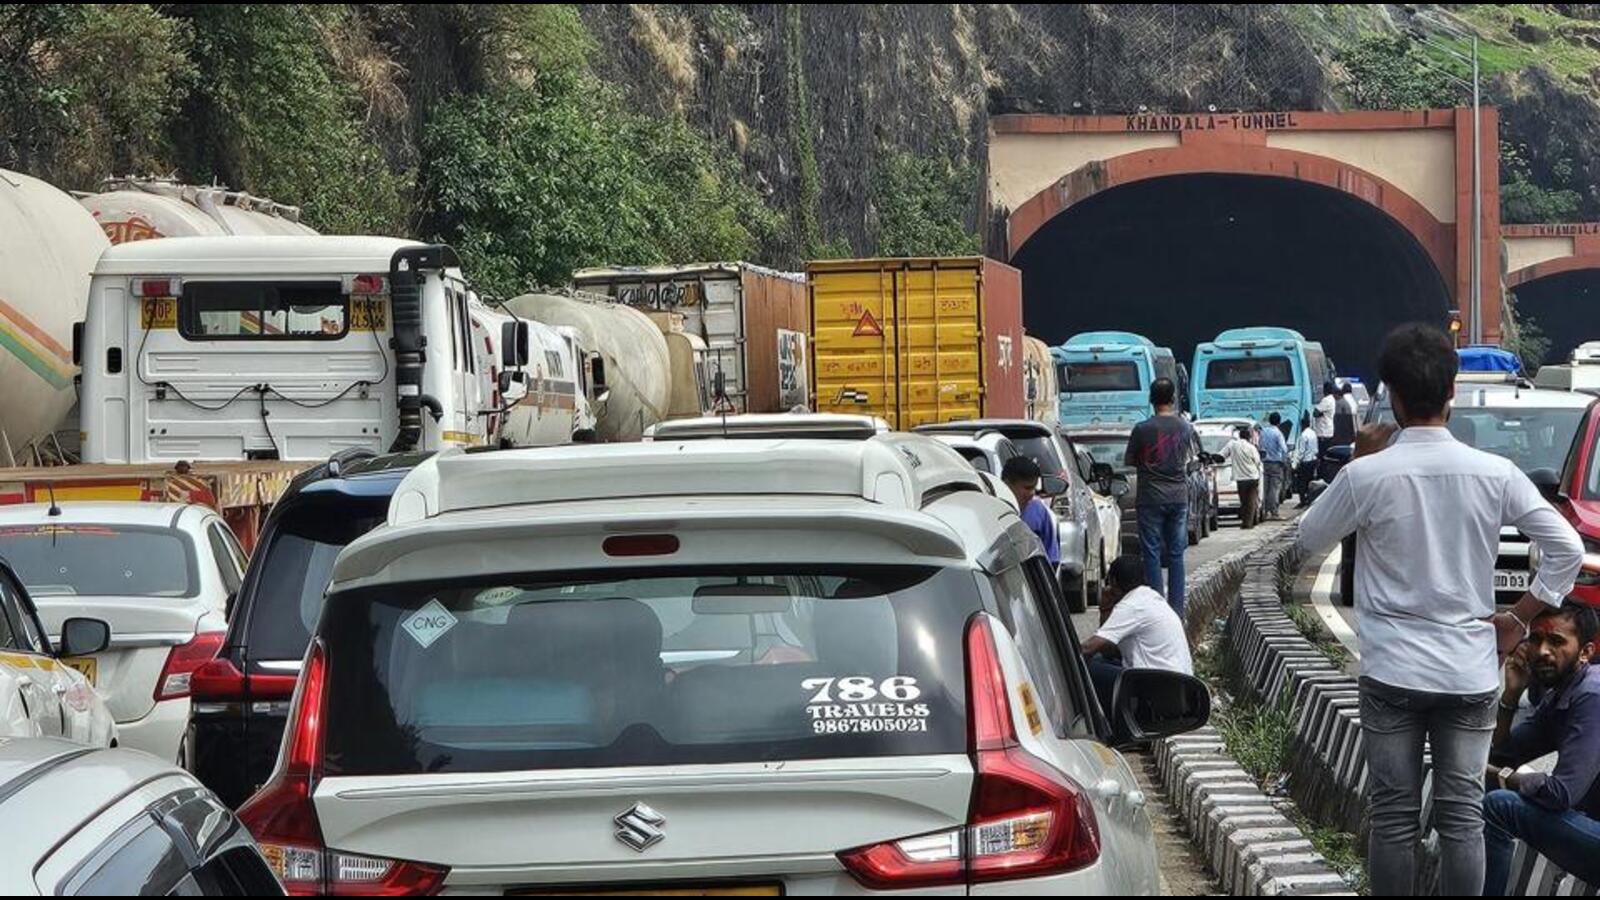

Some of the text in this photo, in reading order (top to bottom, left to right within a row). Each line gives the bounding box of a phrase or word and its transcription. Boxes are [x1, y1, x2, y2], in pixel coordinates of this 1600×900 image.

[413, 615, 447, 631] CNG
[801, 676, 921, 702] 786
[806, 703, 930, 719] TRAVELS
[813, 718, 928, 734] 9867805021
